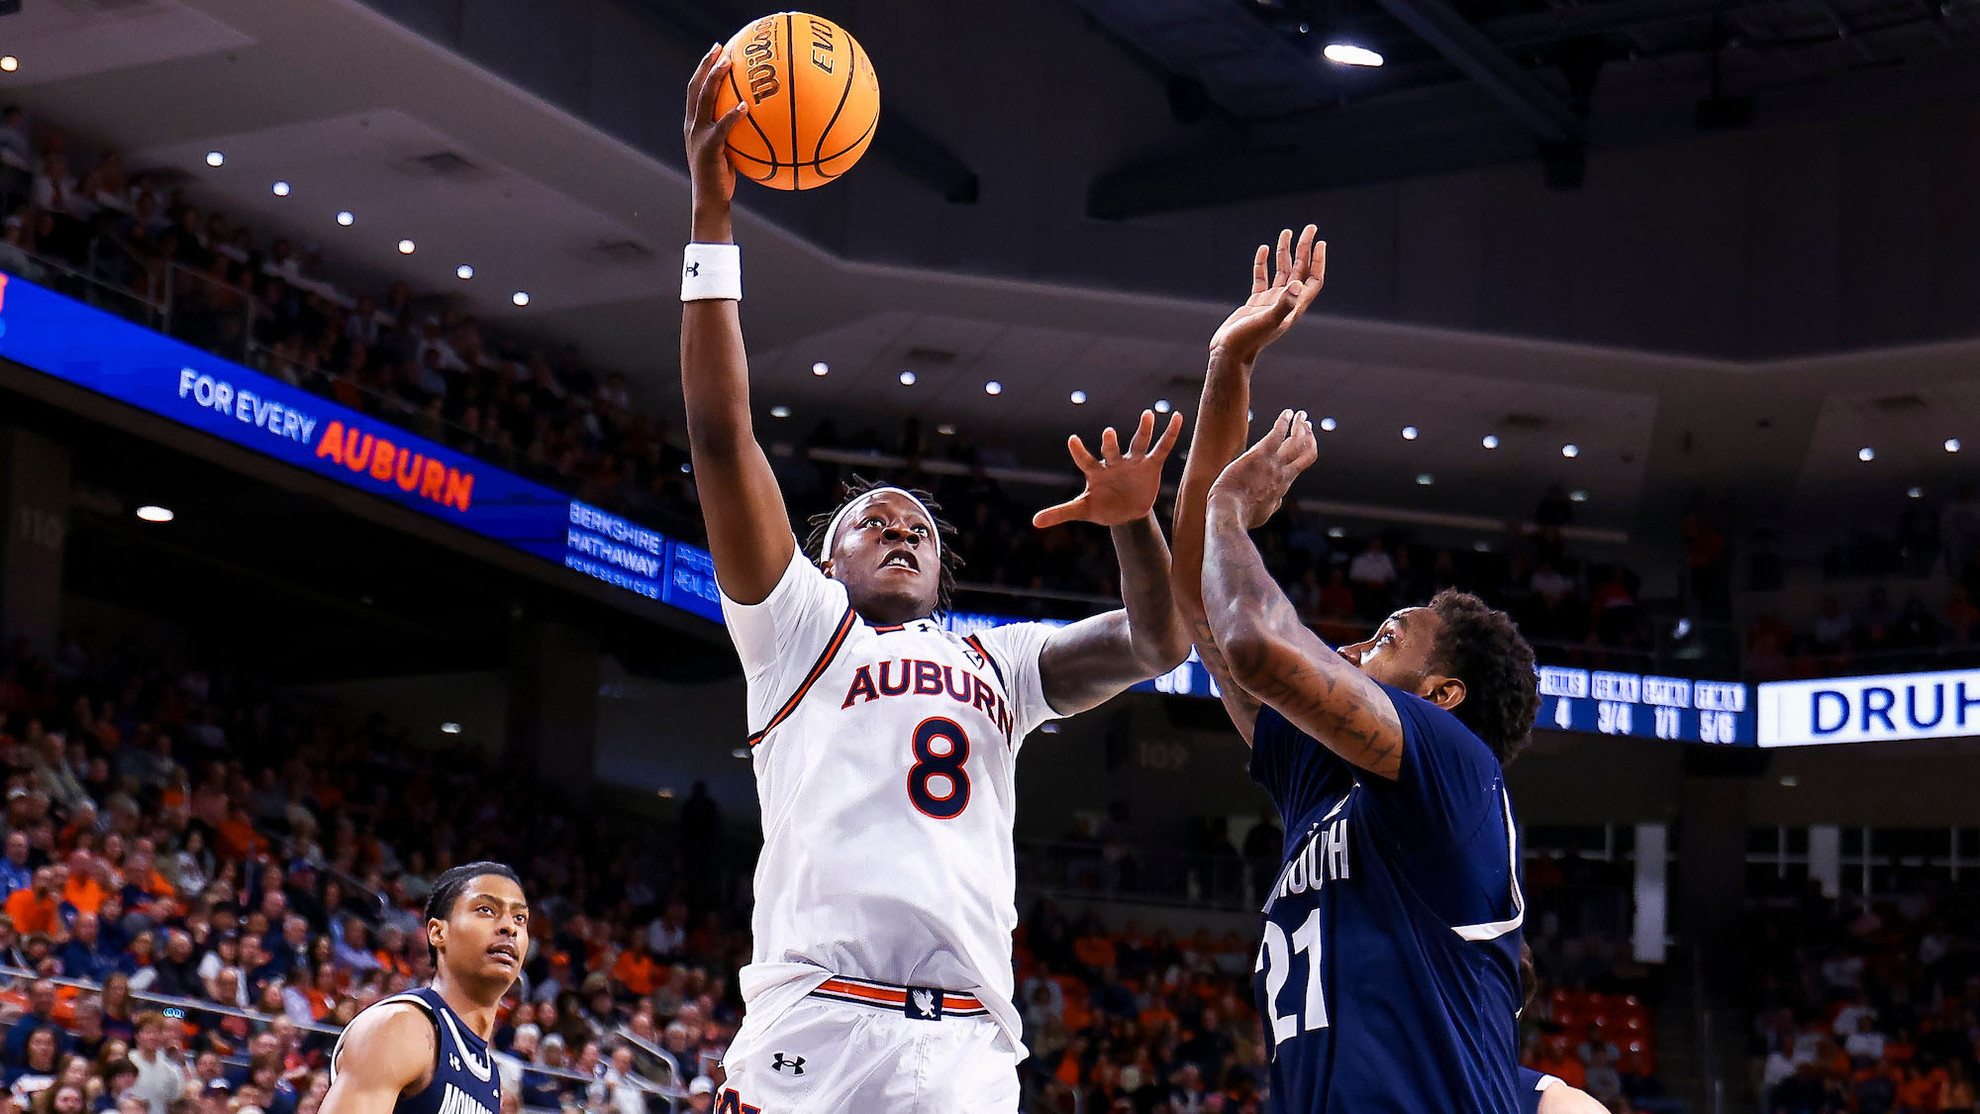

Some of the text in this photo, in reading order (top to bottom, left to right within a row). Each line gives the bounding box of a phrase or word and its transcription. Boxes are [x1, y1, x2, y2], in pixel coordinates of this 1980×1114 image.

[178, 367, 475, 513] FOR EVERY AUBURN
[567, 528, 662, 579] HATHAWAY
[569, 500, 665, 556] BERKSHIRE
[841, 659, 1014, 752] AUBURN
[1811, 682, 1980, 735] DRUH
[907, 716, 971, 820] 8
[1255, 908, 1329, 1047] 21
